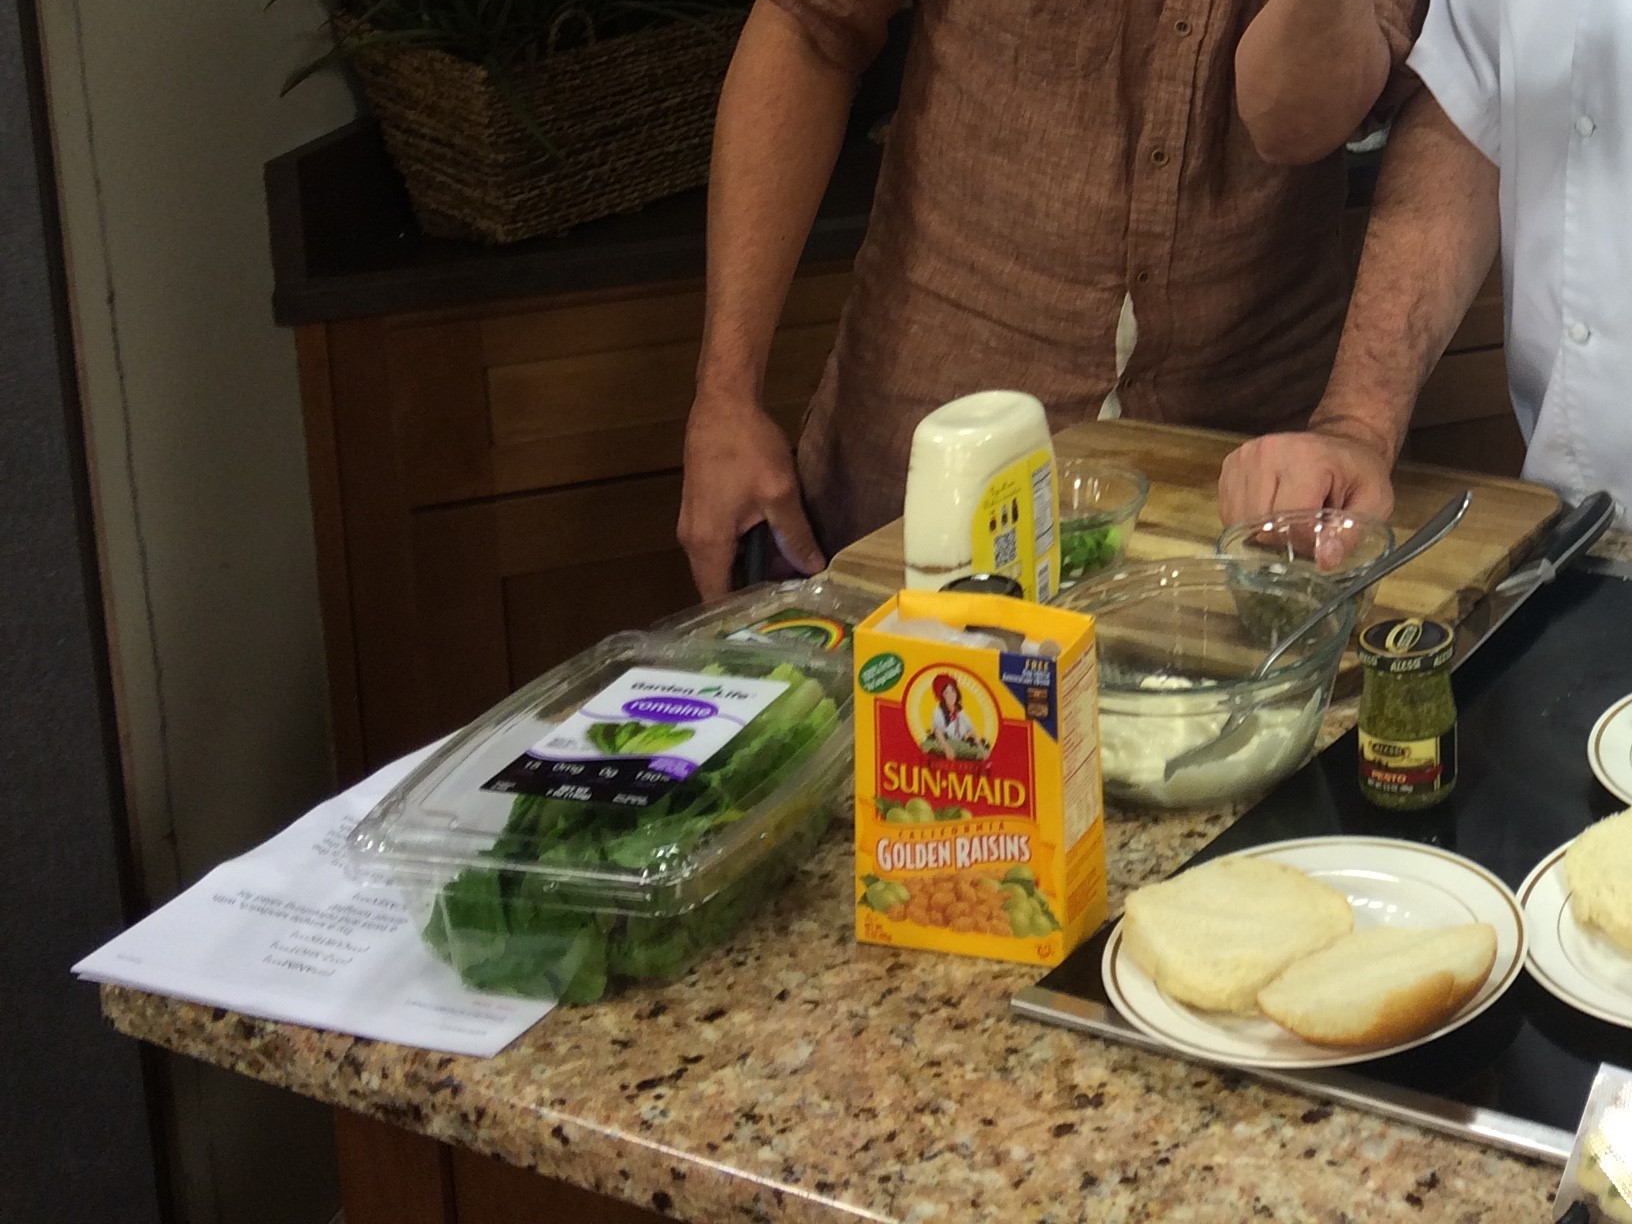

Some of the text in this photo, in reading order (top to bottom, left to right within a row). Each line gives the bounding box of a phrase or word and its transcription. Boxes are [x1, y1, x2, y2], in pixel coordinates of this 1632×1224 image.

[630, 700, 712, 718] romaine
[877, 833, 1032, 872] GOLDEN RAISINS
